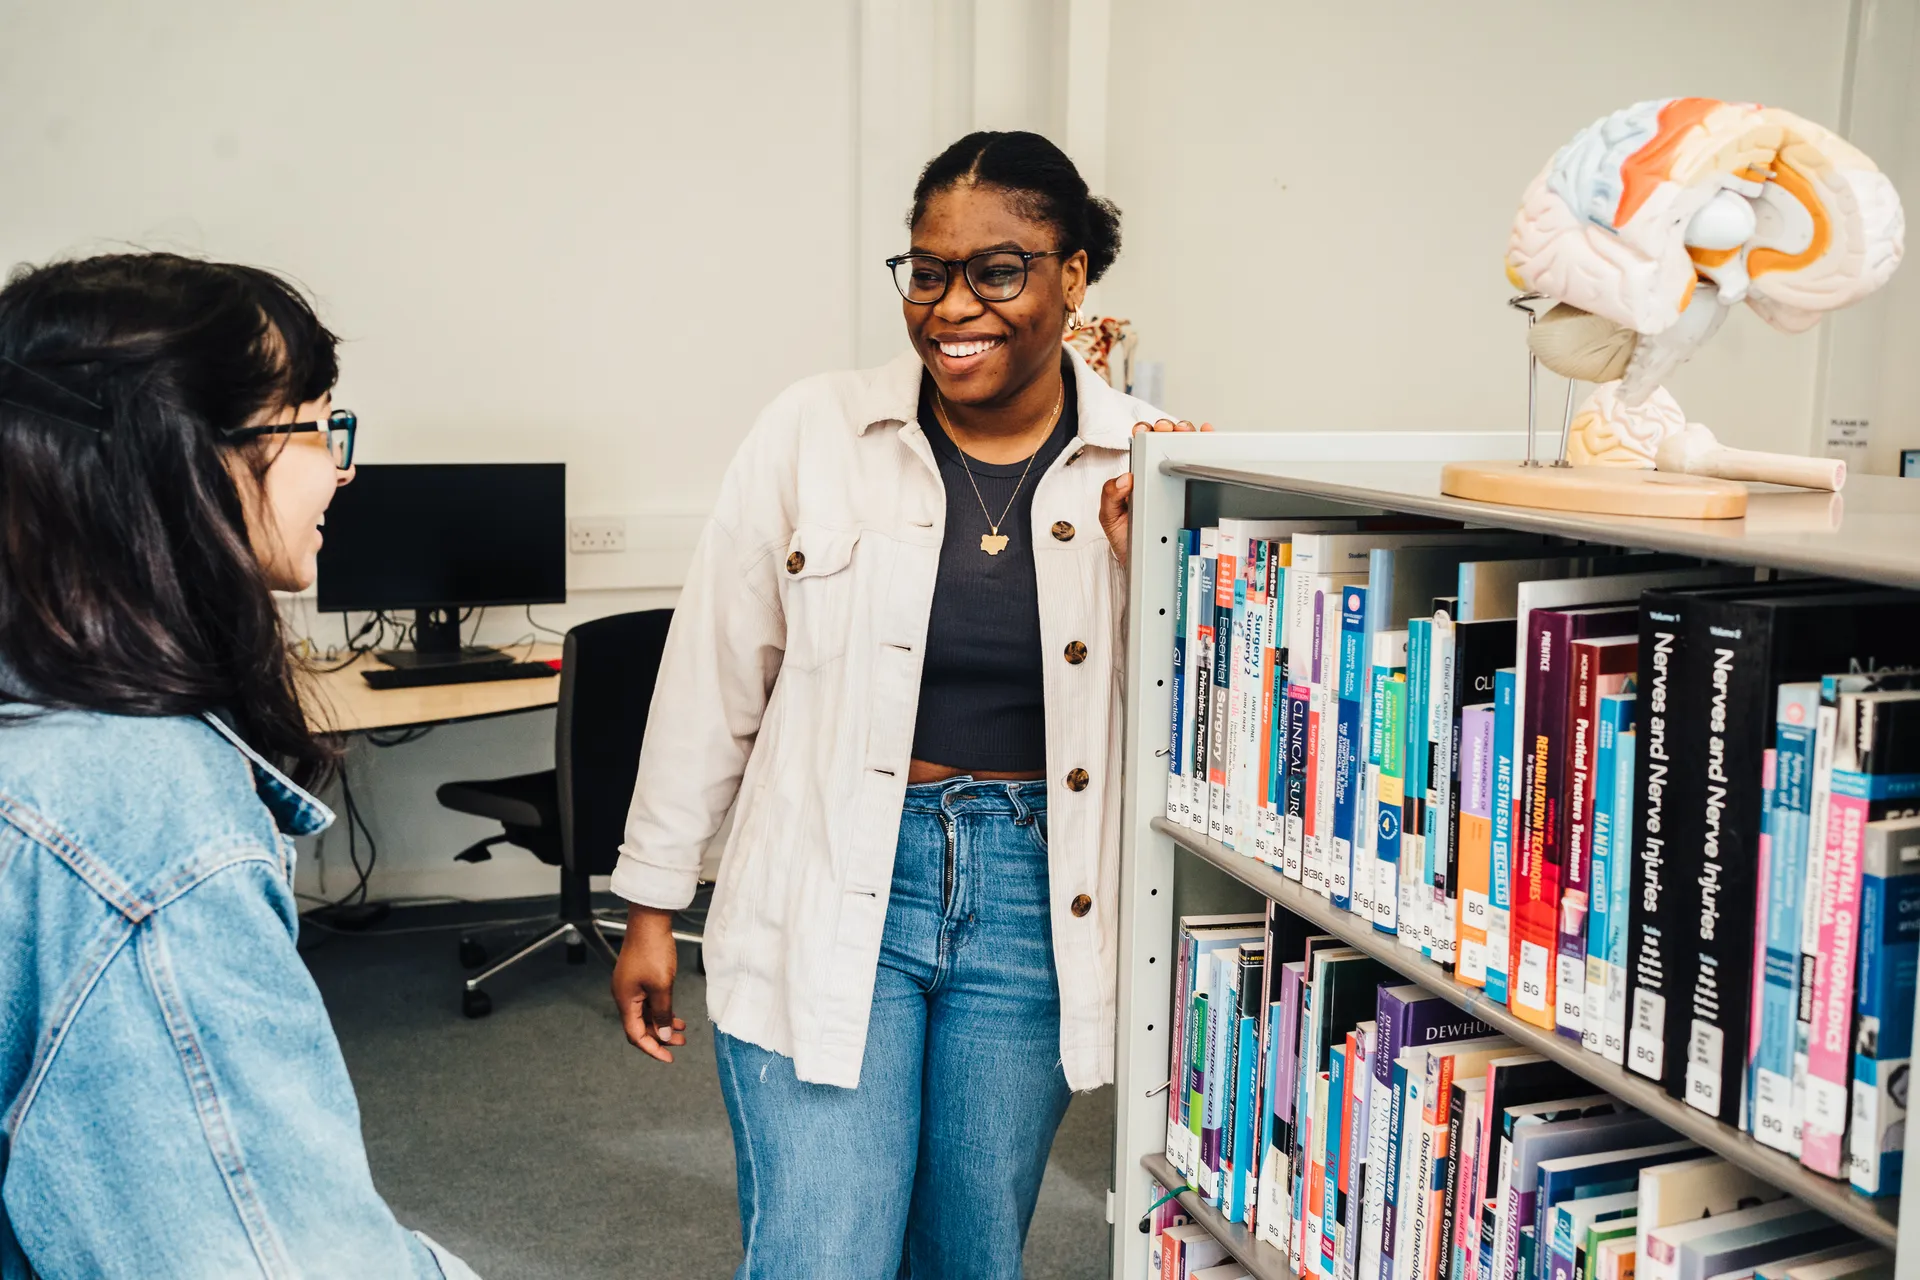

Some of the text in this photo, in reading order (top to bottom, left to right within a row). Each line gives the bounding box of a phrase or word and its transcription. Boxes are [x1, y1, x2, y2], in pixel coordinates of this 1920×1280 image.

[1175, 543, 1185, 620] Fisher Ahmed Dasgupta
[1267, 554, 1279, 644] Master Medicine
[1217, 616, 1230, 683] Essential
[1245, 610, 1255, 675] Surgery 2
[1253, 614, 1264, 667] Surgery
[1540, 630, 1552, 672] PRENTICE
[1374, 673, 1386, 718] Surgical
[1652, 633, 1675, 712] Nerves
[1710, 648, 1734, 733] Nerves
[1171, 677, 1181, 721] Introduction
[1195, 670, 1208, 761] Principles Practice
[1263, 691, 1271, 724] Surgery
[1384, 689, 1392, 729] CLINICAL
[1169, 732, 1179, 759] Surgery
[1213, 690, 1227, 762] Surgery
[1290, 700, 1304, 774] CLINICAL
[1309, 724, 1318, 757] Surgery
[1439, 656, 1451, 806] Clinical Cases Surgery Exams
[1482, 720, 1491, 753] OXFORD
[1649, 716, 1670, 760] and
[1471, 736, 1483, 809] ANAESTHESIA
[1481, 755, 1489, 799] HANDBOOK
[1708, 736, 1728, 783] and
[1193, 813, 1202, 824] BG
[1496, 754, 1511, 839] ANESTHESIA
[1529, 735, 1549, 901] REHABILITATION TECHNIQUES
[1569, 718, 1590, 883] Practical Fracture Treatment
[1646, 763, 1668, 833] Nerve
[1211, 820, 1220, 831] BG
[1224, 825, 1234, 836] BG
[1256, 838, 1265, 850] BG
[1382, 817, 1390, 832] 4
[1593, 812, 1610, 857] HAND
[1704, 785, 1727, 858] Nerve
[1287, 857, 1297, 870] BG
[1334, 873, 1346, 886] BG
[1640, 837, 1665, 913] Injuries
[1838, 806, 1862, 905] ESSENTIAL
[1378, 903, 1391, 916] BG
[1469, 901, 1484, 915] BG
[1697, 861, 1722, 941] Injuries
[1819, 848, 1841, 927] TRAUMA
[1400, 922, 1412, 935] BG
[1523, 981, 1539, 996] BG
[1825, 909, 1853, 1052] ORTHOPAEDICS
[1563, 1002, 1580, 1017] BG
[1377, 1010, 1386, 1060] TEXTBOOK
[1381, 1014, 1392, 1078] DEWHURST'S
[1583, 1028, 1598, 1044] BG
[1605, 1034, 1621, 1051] BG
[1637, 1046, 1655, 1063] BG
[1206, 1008, 1218, 1125] ORTHOPEDIC SECRETS
[1226, 1011, 1241, 1157] Clinical Orthopaedic Examination
[1249, 1067, 1257, 1095] BACK
[1693, 1080, 1714, 1098] BG
[1390, 1083, 1401, 1133] OBSTETRICS
[1439, 1059, 1450, 1123] SECOND EDITION
[1348, 1101, 1360, 1186] GYNAECOLOGY
[1448, 1117, 1460, 1160] Essential
[1761, 1114, 1783, 1133] BG
[1372, 1097, 1391, 1208] OBSTETRICS
[1385, 1143, 1397, 1202] GYNAECOLOGY
[1418, 1132, 1431, 1191] Obstetrics
[1324, 1150, 1337, 1233] ENT SECRETS
[1416, 1193, 1425, 1217] and
[1444, 1160, 1457, 1207] Obstetrics
[1460, 1166, 1470, 1210] Obstetrics
[1269, 1224, 1279, 1237] BG
[1344, 1187, 1355, 1261] ILLUSTRATED
[1438, 1218, 1452, 1277] Gynaecology
